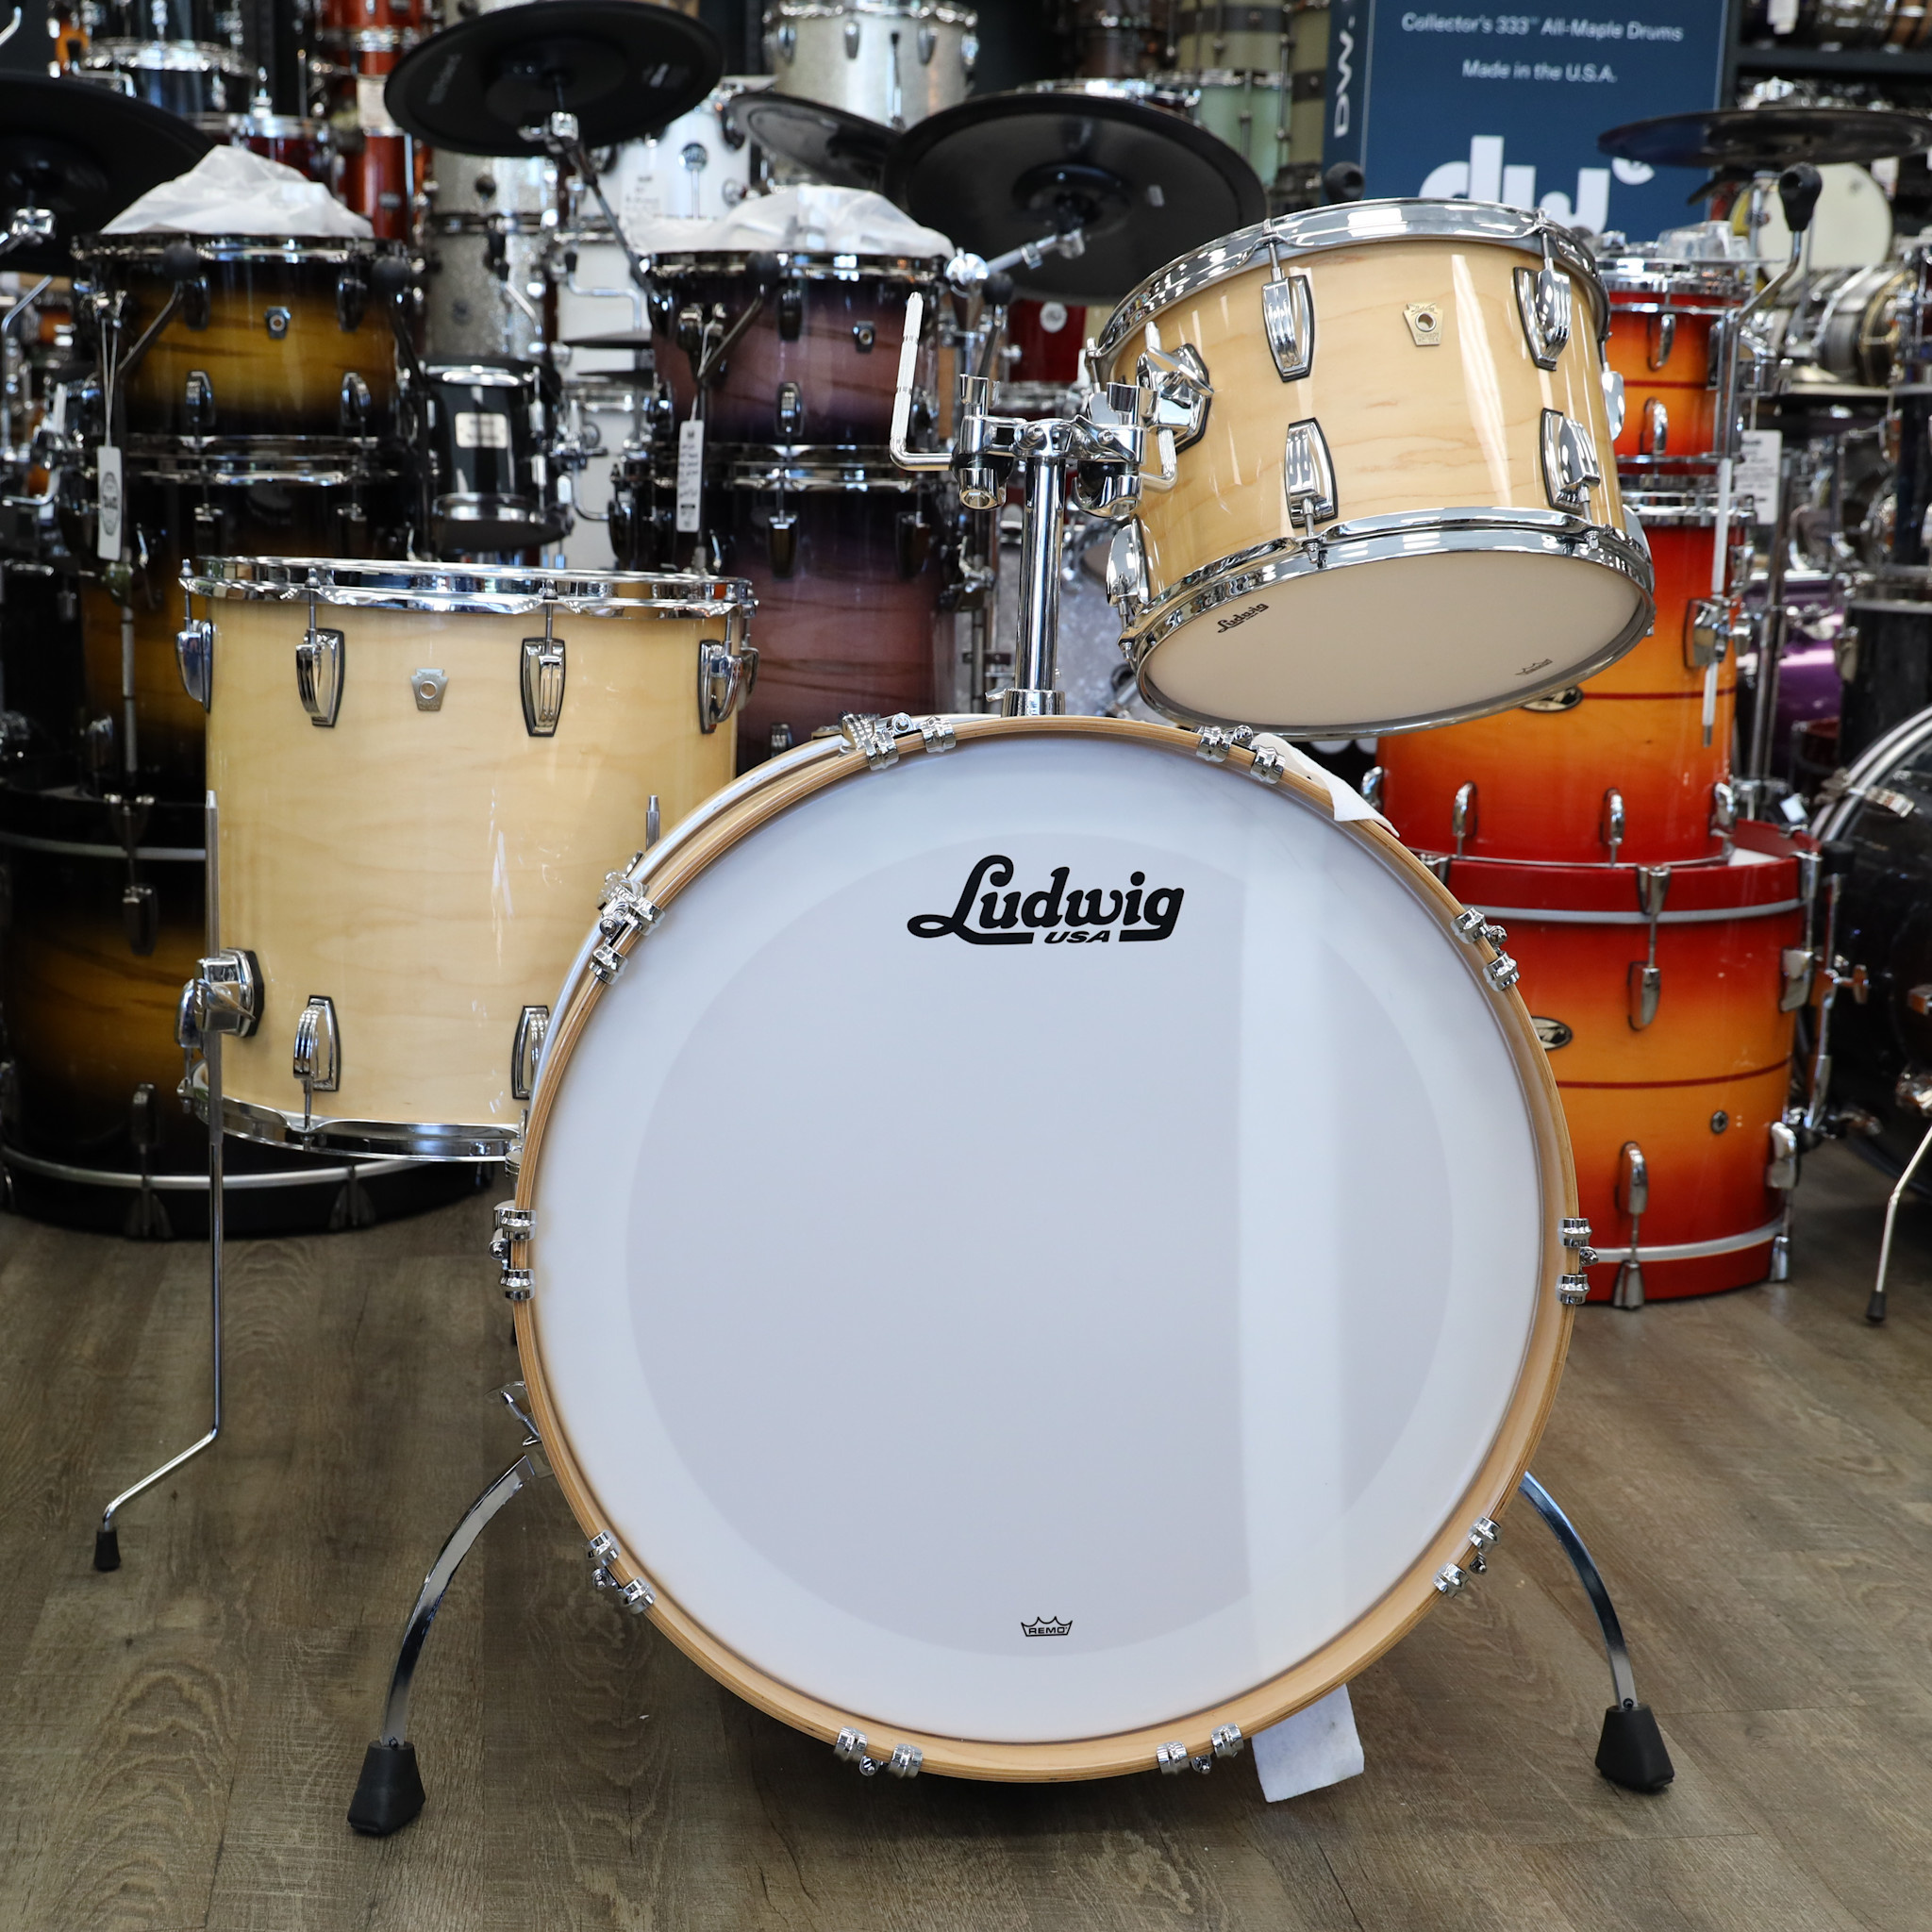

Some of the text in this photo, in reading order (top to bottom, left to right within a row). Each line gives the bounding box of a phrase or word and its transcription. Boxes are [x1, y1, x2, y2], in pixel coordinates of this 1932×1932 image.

[1402, 12, 1493, 34] Collector's
[1541, 17, 1624, 42] All-Maple
[1626, 21, 1684, 42] Drums
[1461, 58, 1618, 83] Made in the U.S.A.
[1217, 603, 1269, 633] Ludwig
[907, 854, 1185, 945] Ludwig
[1043, 929, 1111, 944] USA
[1028, 1626, 1066, 1635] REMO
